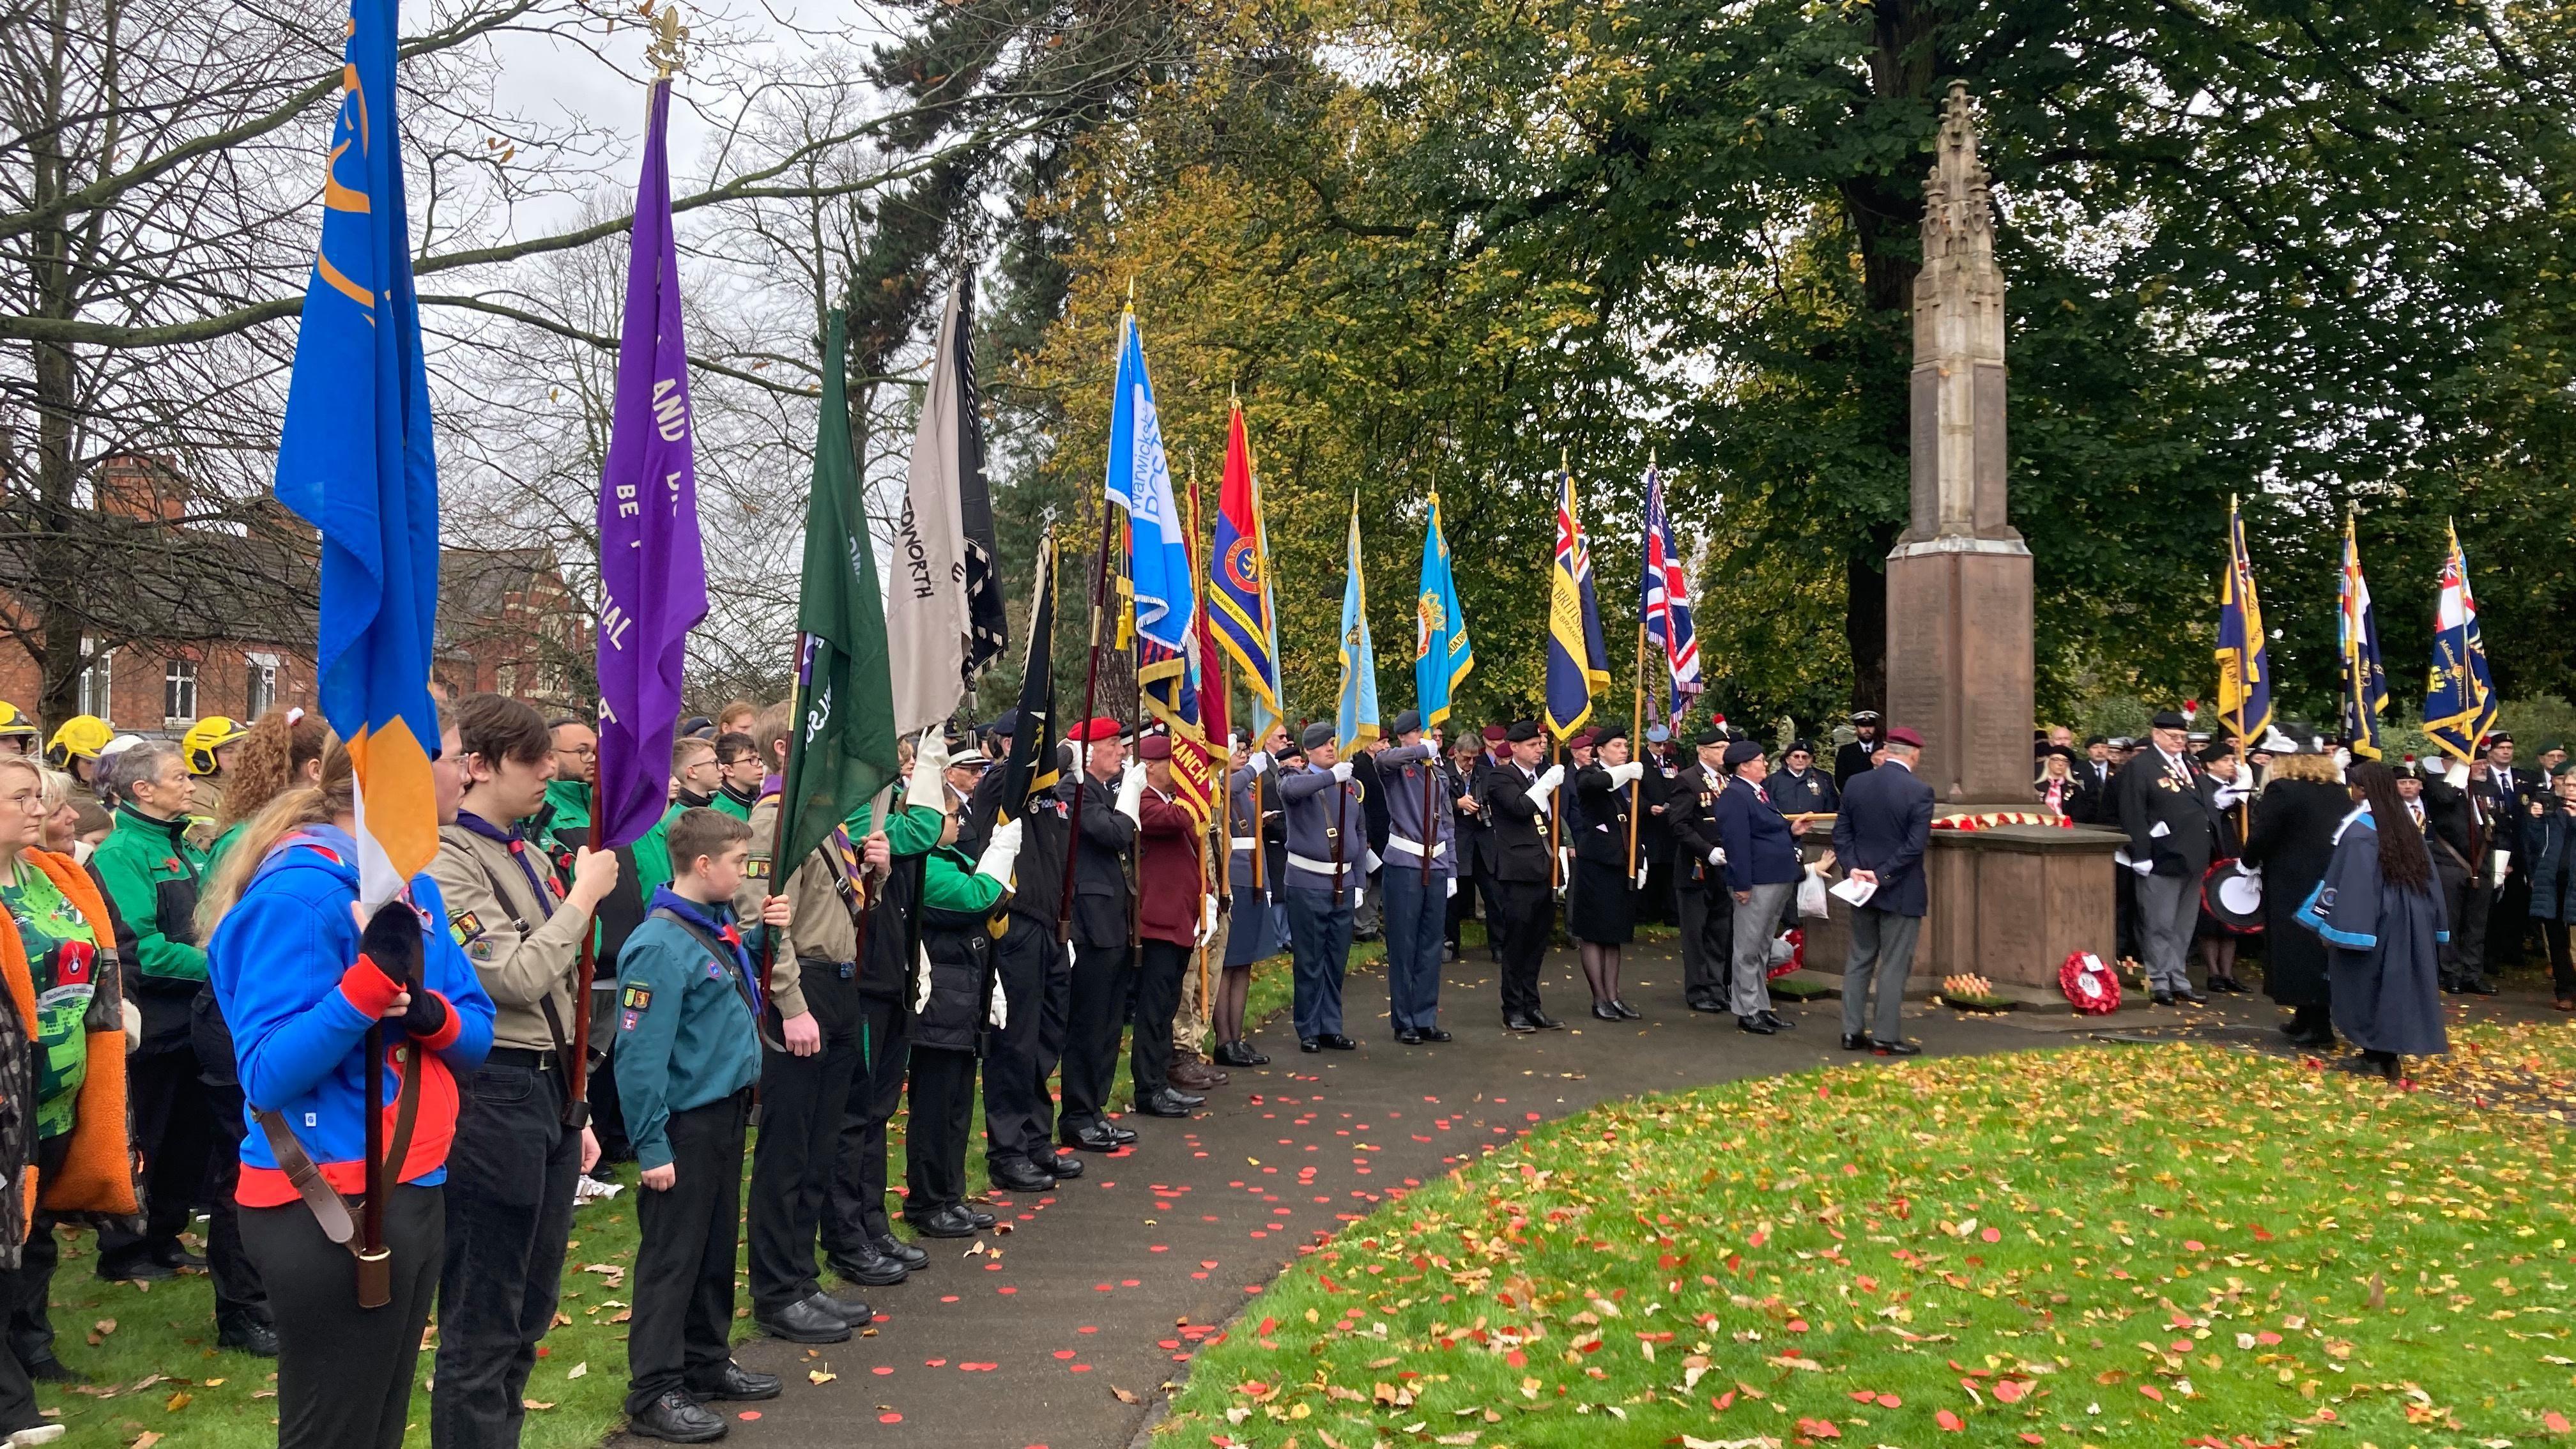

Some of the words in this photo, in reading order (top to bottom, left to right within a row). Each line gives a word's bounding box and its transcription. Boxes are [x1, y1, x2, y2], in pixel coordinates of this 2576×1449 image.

[652, 378, 686, 442] AND
[900, 495, 934, 599] EDWORTH
[1227, 540, 1245, 564] ARMY
[600, 578, 632, 651] RIAL
[1211, 588, 1233, 611] MIDLANDS
[1171, 730, 1209, 785] RANCH
